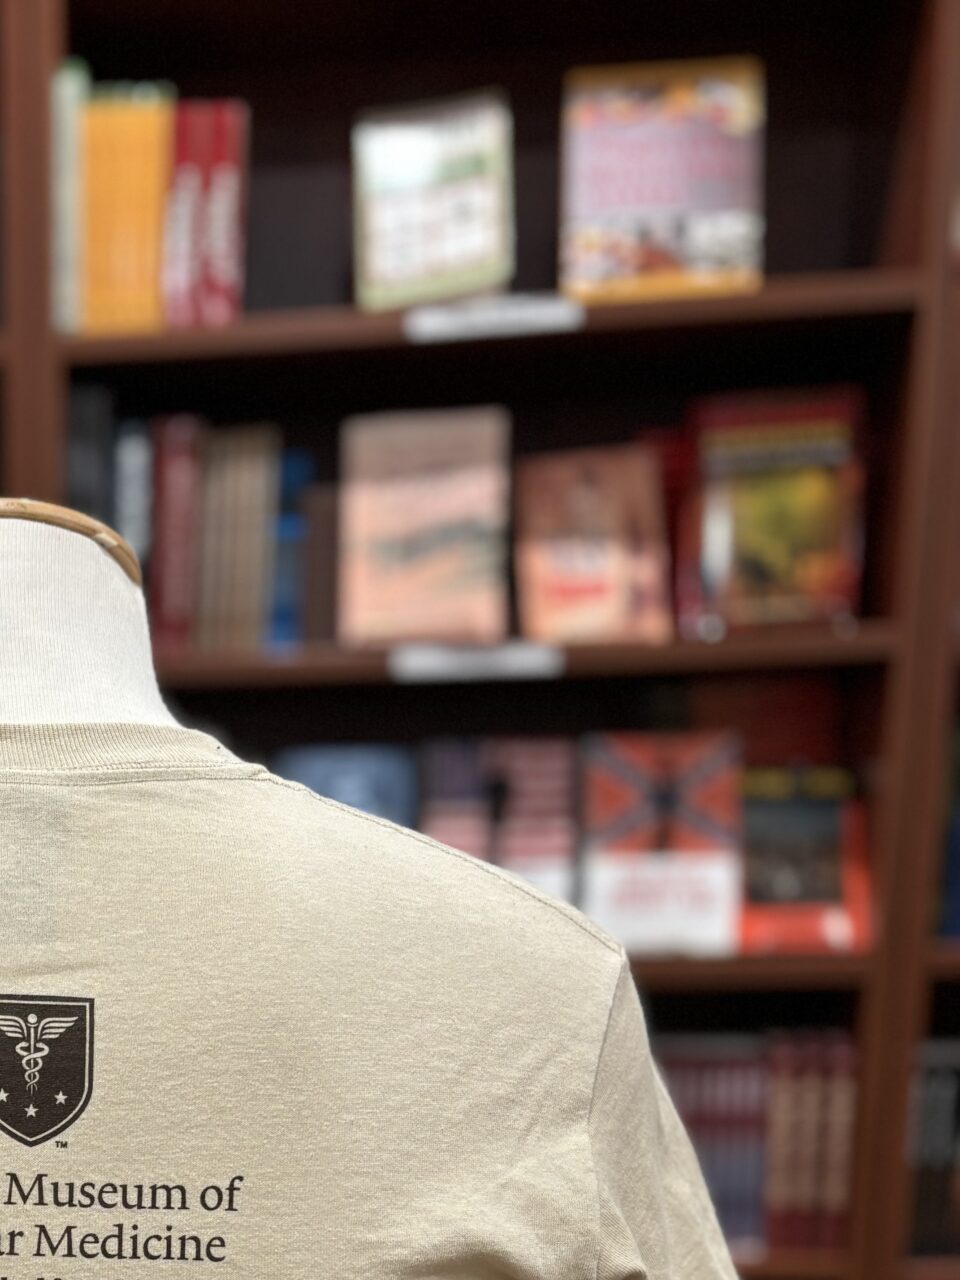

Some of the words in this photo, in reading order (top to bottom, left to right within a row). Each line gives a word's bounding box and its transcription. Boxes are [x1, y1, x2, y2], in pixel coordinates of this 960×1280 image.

[4, 1173, 189, 1209] Museum
[200, 1176, 243, 1211] of
[33, 1224, 225, 1262] Medicine
